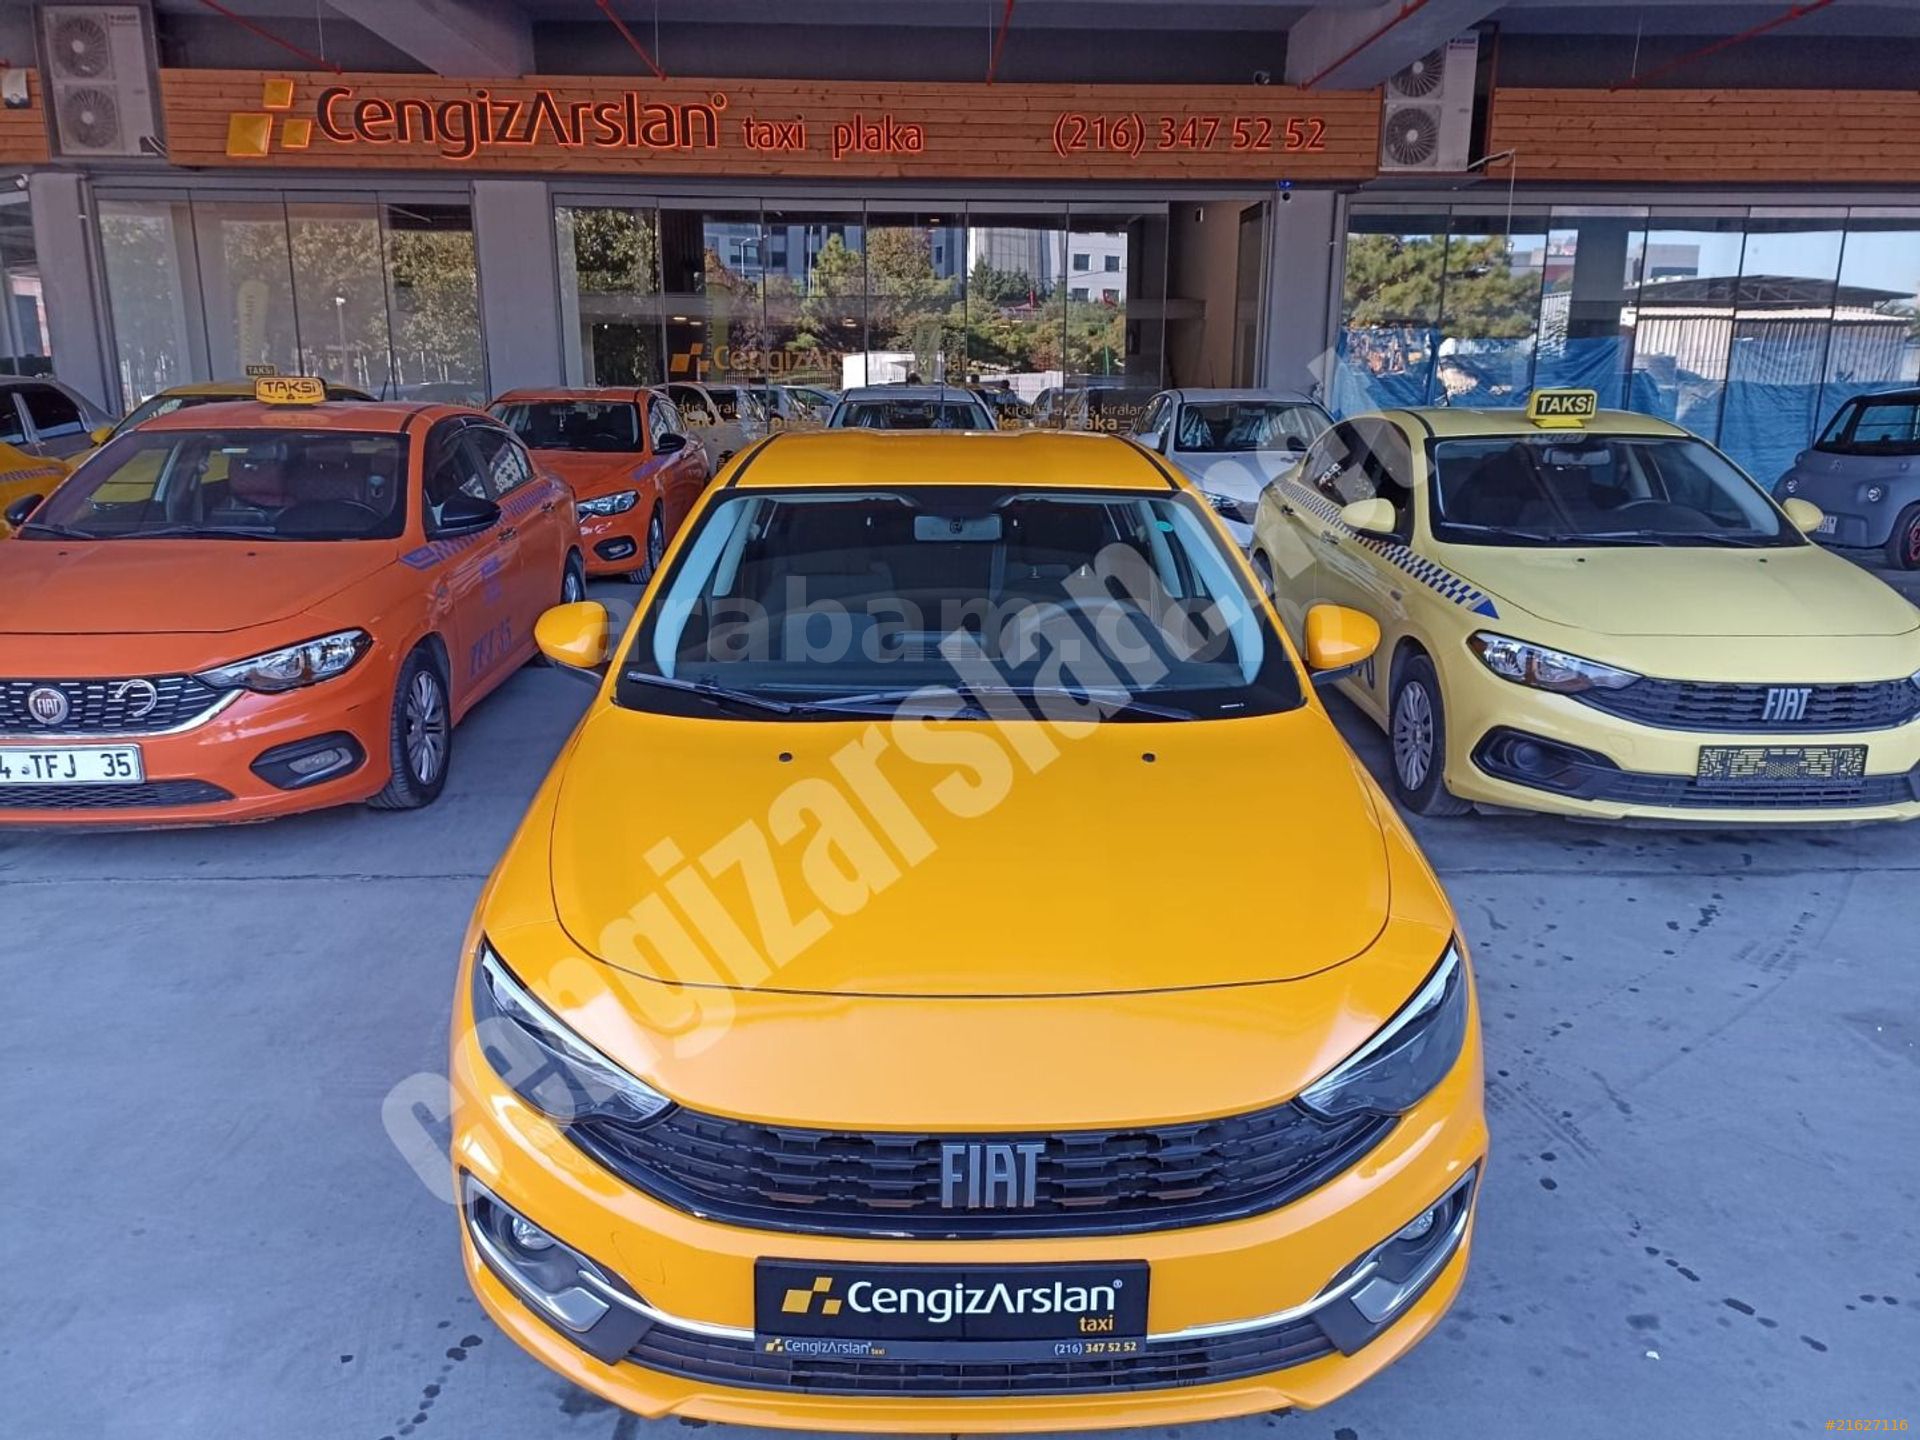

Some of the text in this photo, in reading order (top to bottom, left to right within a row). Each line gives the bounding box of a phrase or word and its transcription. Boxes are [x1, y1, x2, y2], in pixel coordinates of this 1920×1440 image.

[743, 114, 806, 151] taxi
[832, 113, 924, 160] plaka
[1053, 112, 1327, 158] (216) 347 52 52
[36, 698, 60, 714] FIAT
[1762, 688, 1813, 720] FIAT
[29, 754, 77, 779] TFJ
[100, 752, 131, 777] 35
[941, 1144, 1046, 1208] FIAT
[1079, 1314, 1114, 1332] taxi
[1054, 1341, 1137, 1355] (216) 347 52 52
